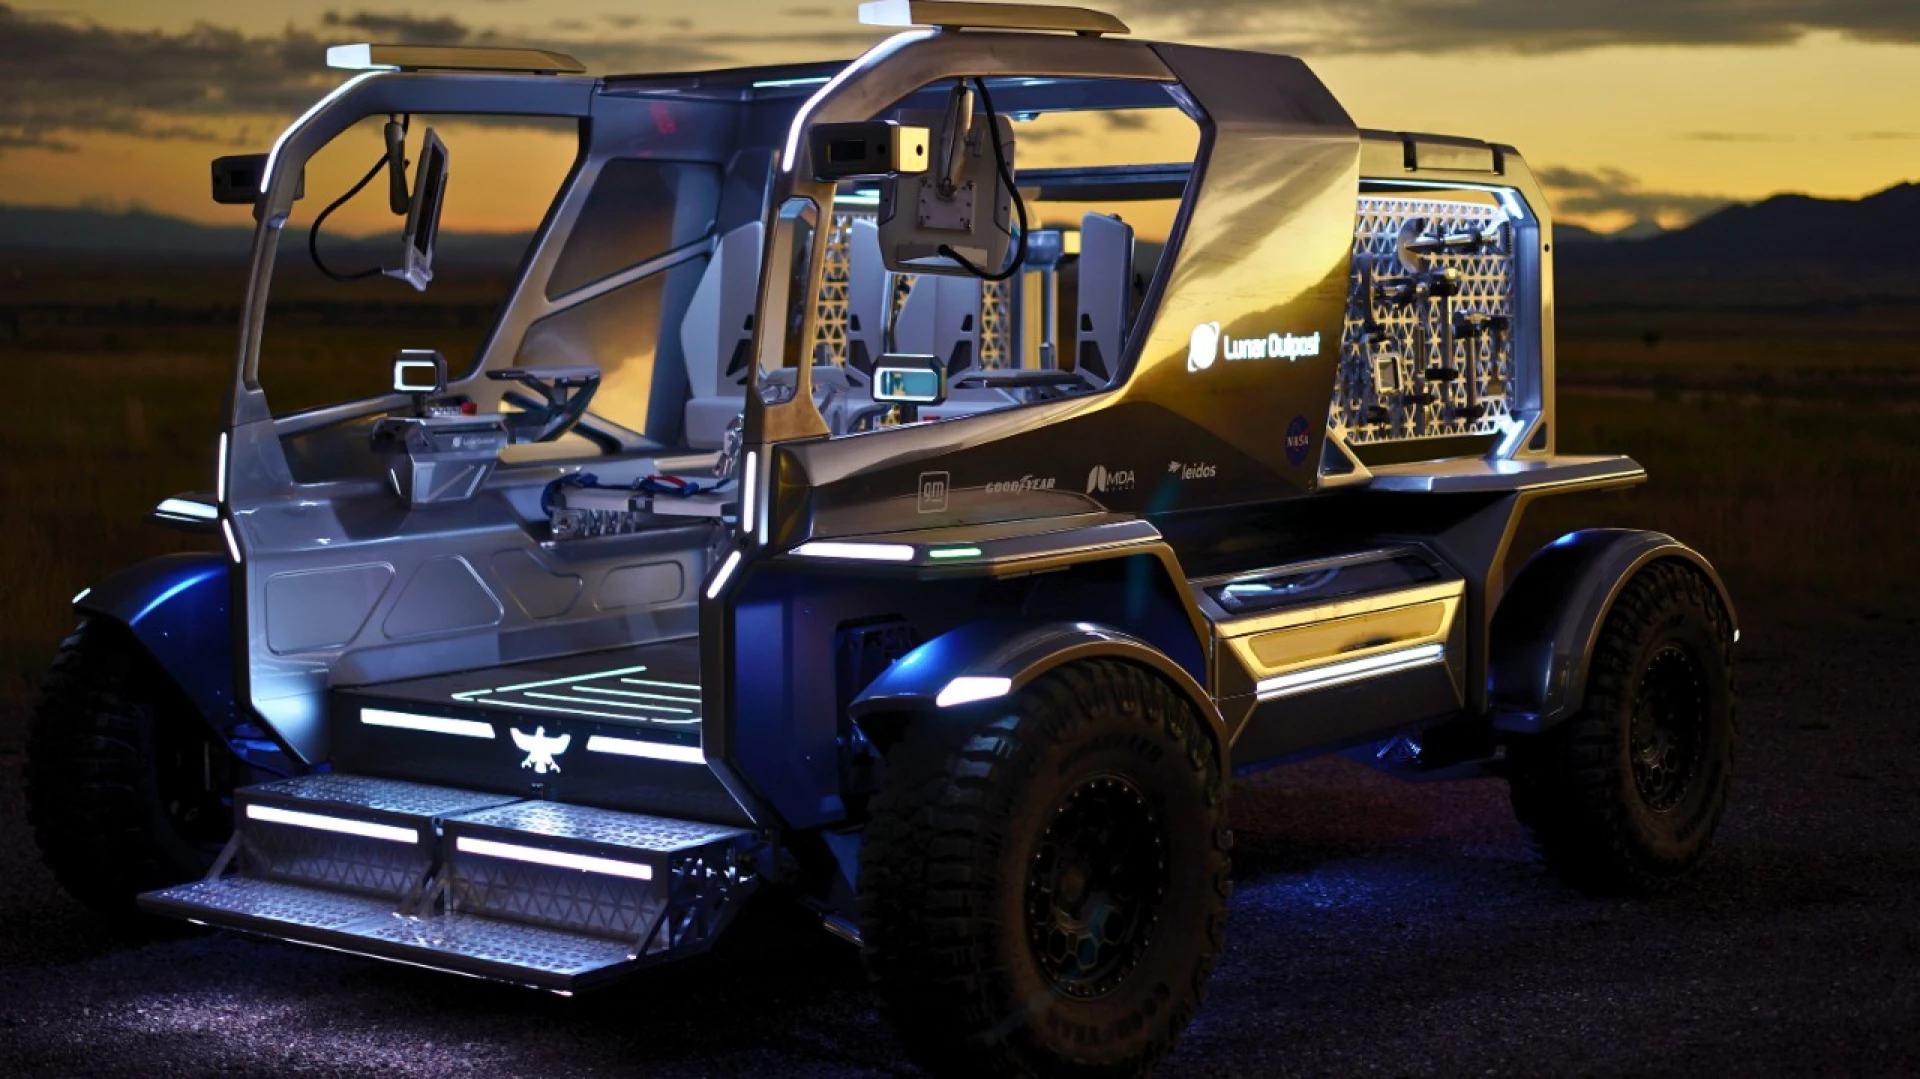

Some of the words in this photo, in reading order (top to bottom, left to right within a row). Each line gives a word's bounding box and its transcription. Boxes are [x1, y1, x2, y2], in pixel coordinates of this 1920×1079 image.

[1224, 334, 1267, 360] Lunar
[1268, 331, 1320, 362] Outpost
[1287, 434, 1309, 447] NASA
[1106, 470, 1135, 485] MDA
[1181, 463, 1216, 480] leidos
[923, 481, 944, 503] gm
[985, 474, 1056, 494] GOODYEAR
